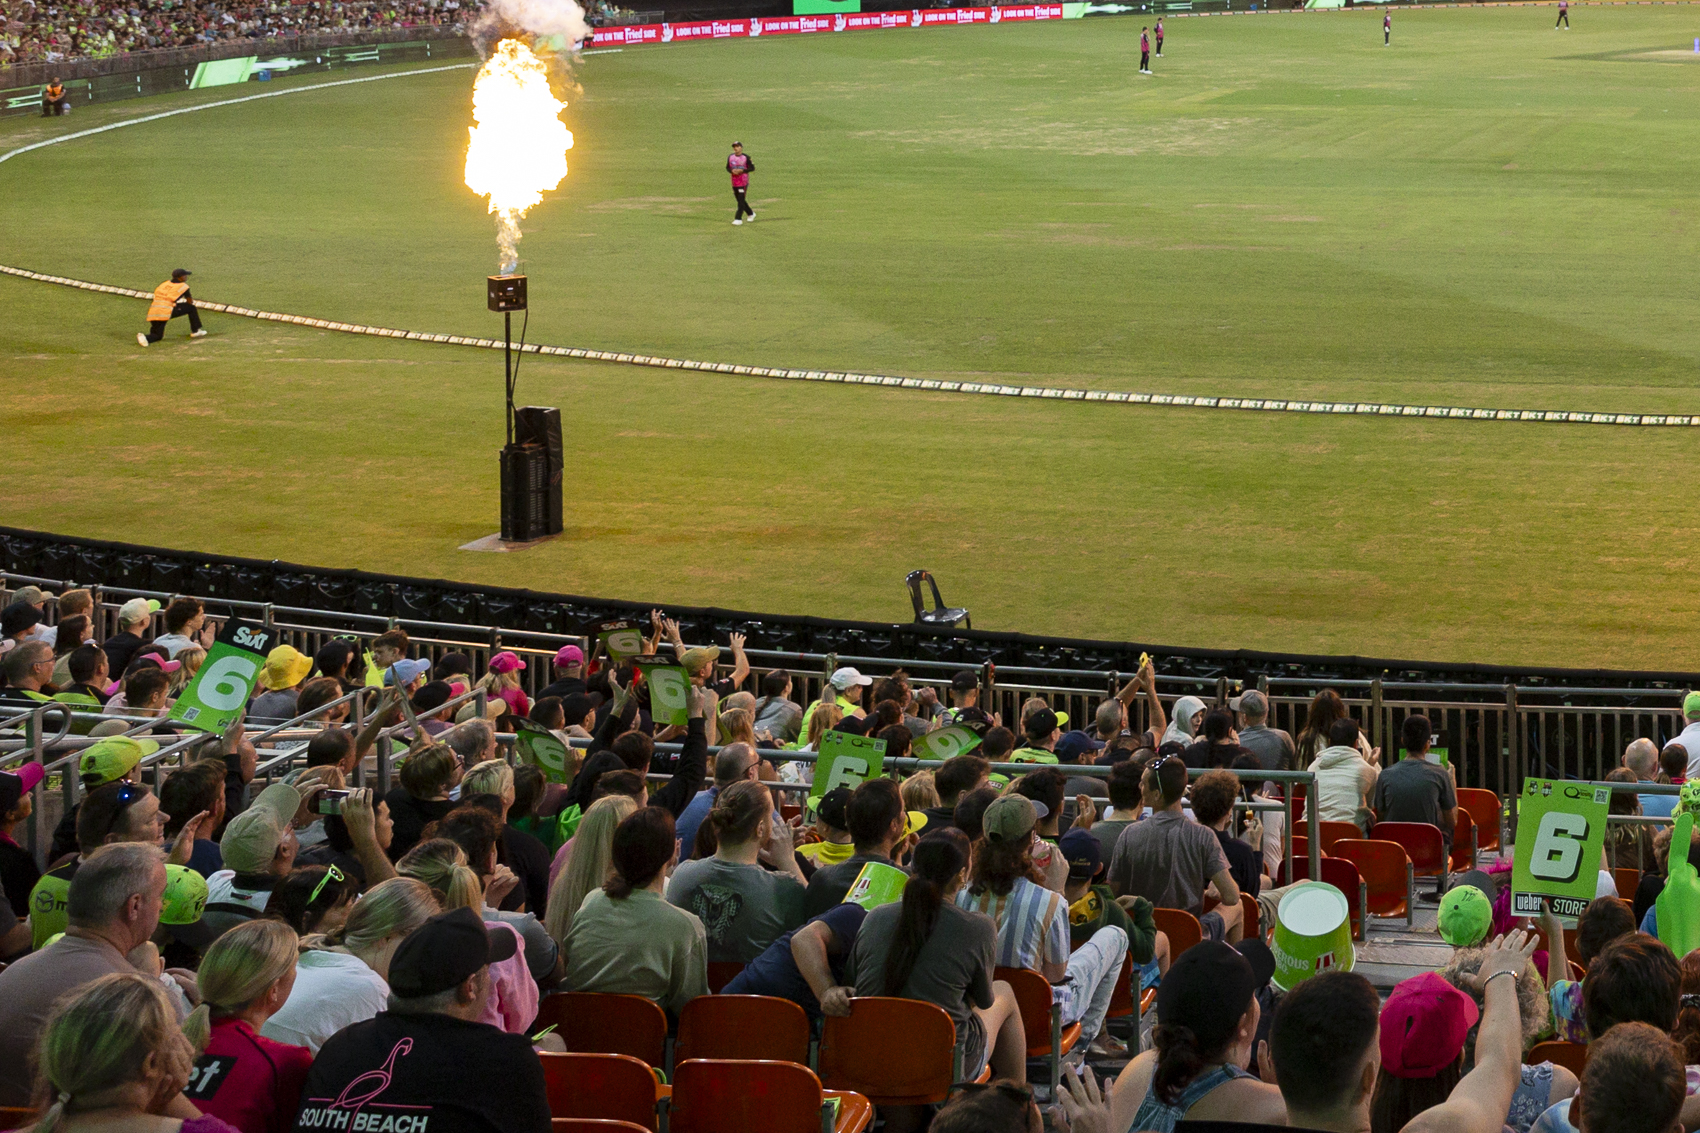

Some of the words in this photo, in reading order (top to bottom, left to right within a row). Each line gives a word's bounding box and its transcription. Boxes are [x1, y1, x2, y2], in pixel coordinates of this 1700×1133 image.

[848, 17, 862, 26] LOOK
[863, 17, 870, 25] ON
[871, 16, 881, 25] THE
[881, 13, 896, 25] Fried
[896, 15, 907, 23] SIDE
[925, 13, 938, 22] LOOK
[938, 13, 946, 21] ON
[946, 12, 956, 21] THE
[957, 9, 973, 21] Fried
[974, 11, 985, 20] SIDE
[1003, 10, 1015, 18] LOOK
[1016, 9, 1023, 17] ON
[1024, 8, 1034, 16] THE
[1035, 6, 1049, 18] Fried
[1050, 7, 1061, 16] SIDE
[676, 28, 691, 37] LOOK
[692, 26, 700, 35] ON
[701, 25, 712, 35] THE
[713, 22, 730, 35] Fried
[731, 24, 744, 33] SIDE
[765, 22, 780, 31] LOOK
[781, 21, 789, 30] ON
[789, 20, 800, 29] THE
[800, 17, 817, 30] Fried
[816, 19, 829, 28] SIDE
[593, 33, 604, 42] OOK
[605, 31, 613, 41] ON
[613, 30, 624, 41] THE
[625, 27, 643, 42] Fried
[643, 29, 656, 39] SIDE
[198, 656, 257, 711] 6
[651, 669, 688, 710] 6
[532, 737, 566, 772] 6
[1529, 811, 1590, 883] 6
[1517, 893, 1542, 911] weber
[299, 1108, 350, 1129] SOUTH
[352, 1112, 428, 1133] BEACH
